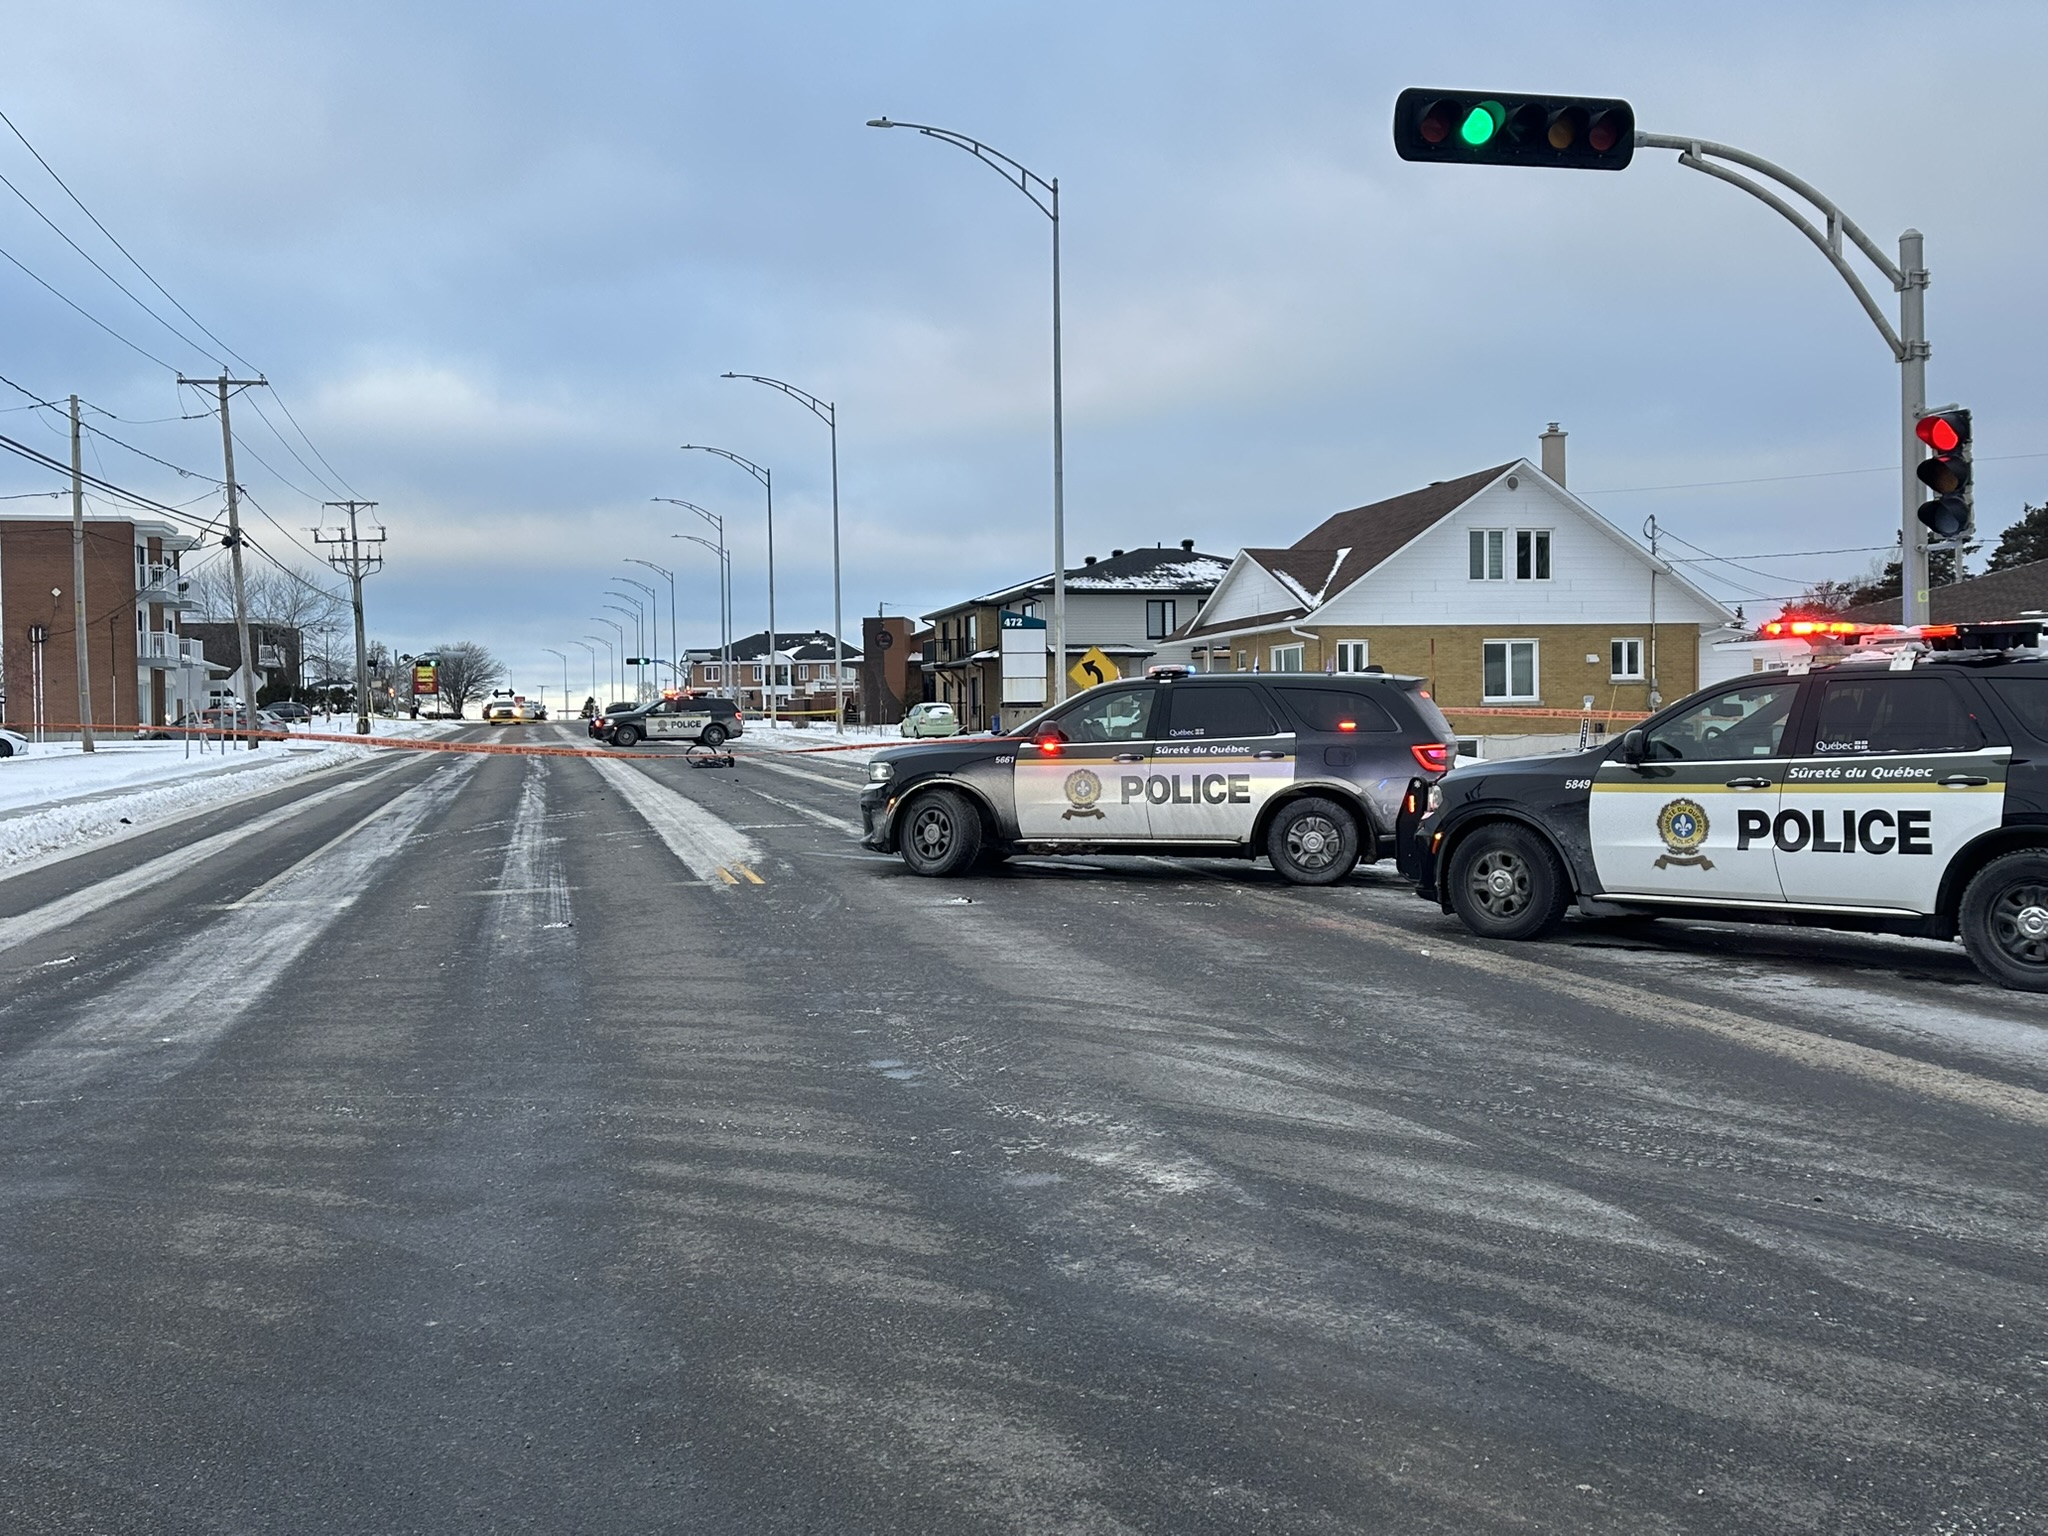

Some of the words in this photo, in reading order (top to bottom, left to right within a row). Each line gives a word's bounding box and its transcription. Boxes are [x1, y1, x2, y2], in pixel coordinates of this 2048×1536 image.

[1003, 617, 1023, 627] 472
[671, 720, 702, 728] POLICE
[1169, 728, 1195, 737] Québec
[1154, 745, 1190, 754] Sûreté
[1192, 745, 1207, 754] du
[1209, 744, 1250, 755] Québec
[1815, 740, 1853, 751] Québec
[995, 755, 1015, 764] 5661
[1788, 766, 1841, 779] Sûreté
[1845, 767, 1867, 778] du
[1871, 766, 1934, 779] Québec
[1120, 773, 1251, 805] POLICE
[1564, 779, 1592, 789] 5849
[1736, 808, 1934, 855] POLICE
